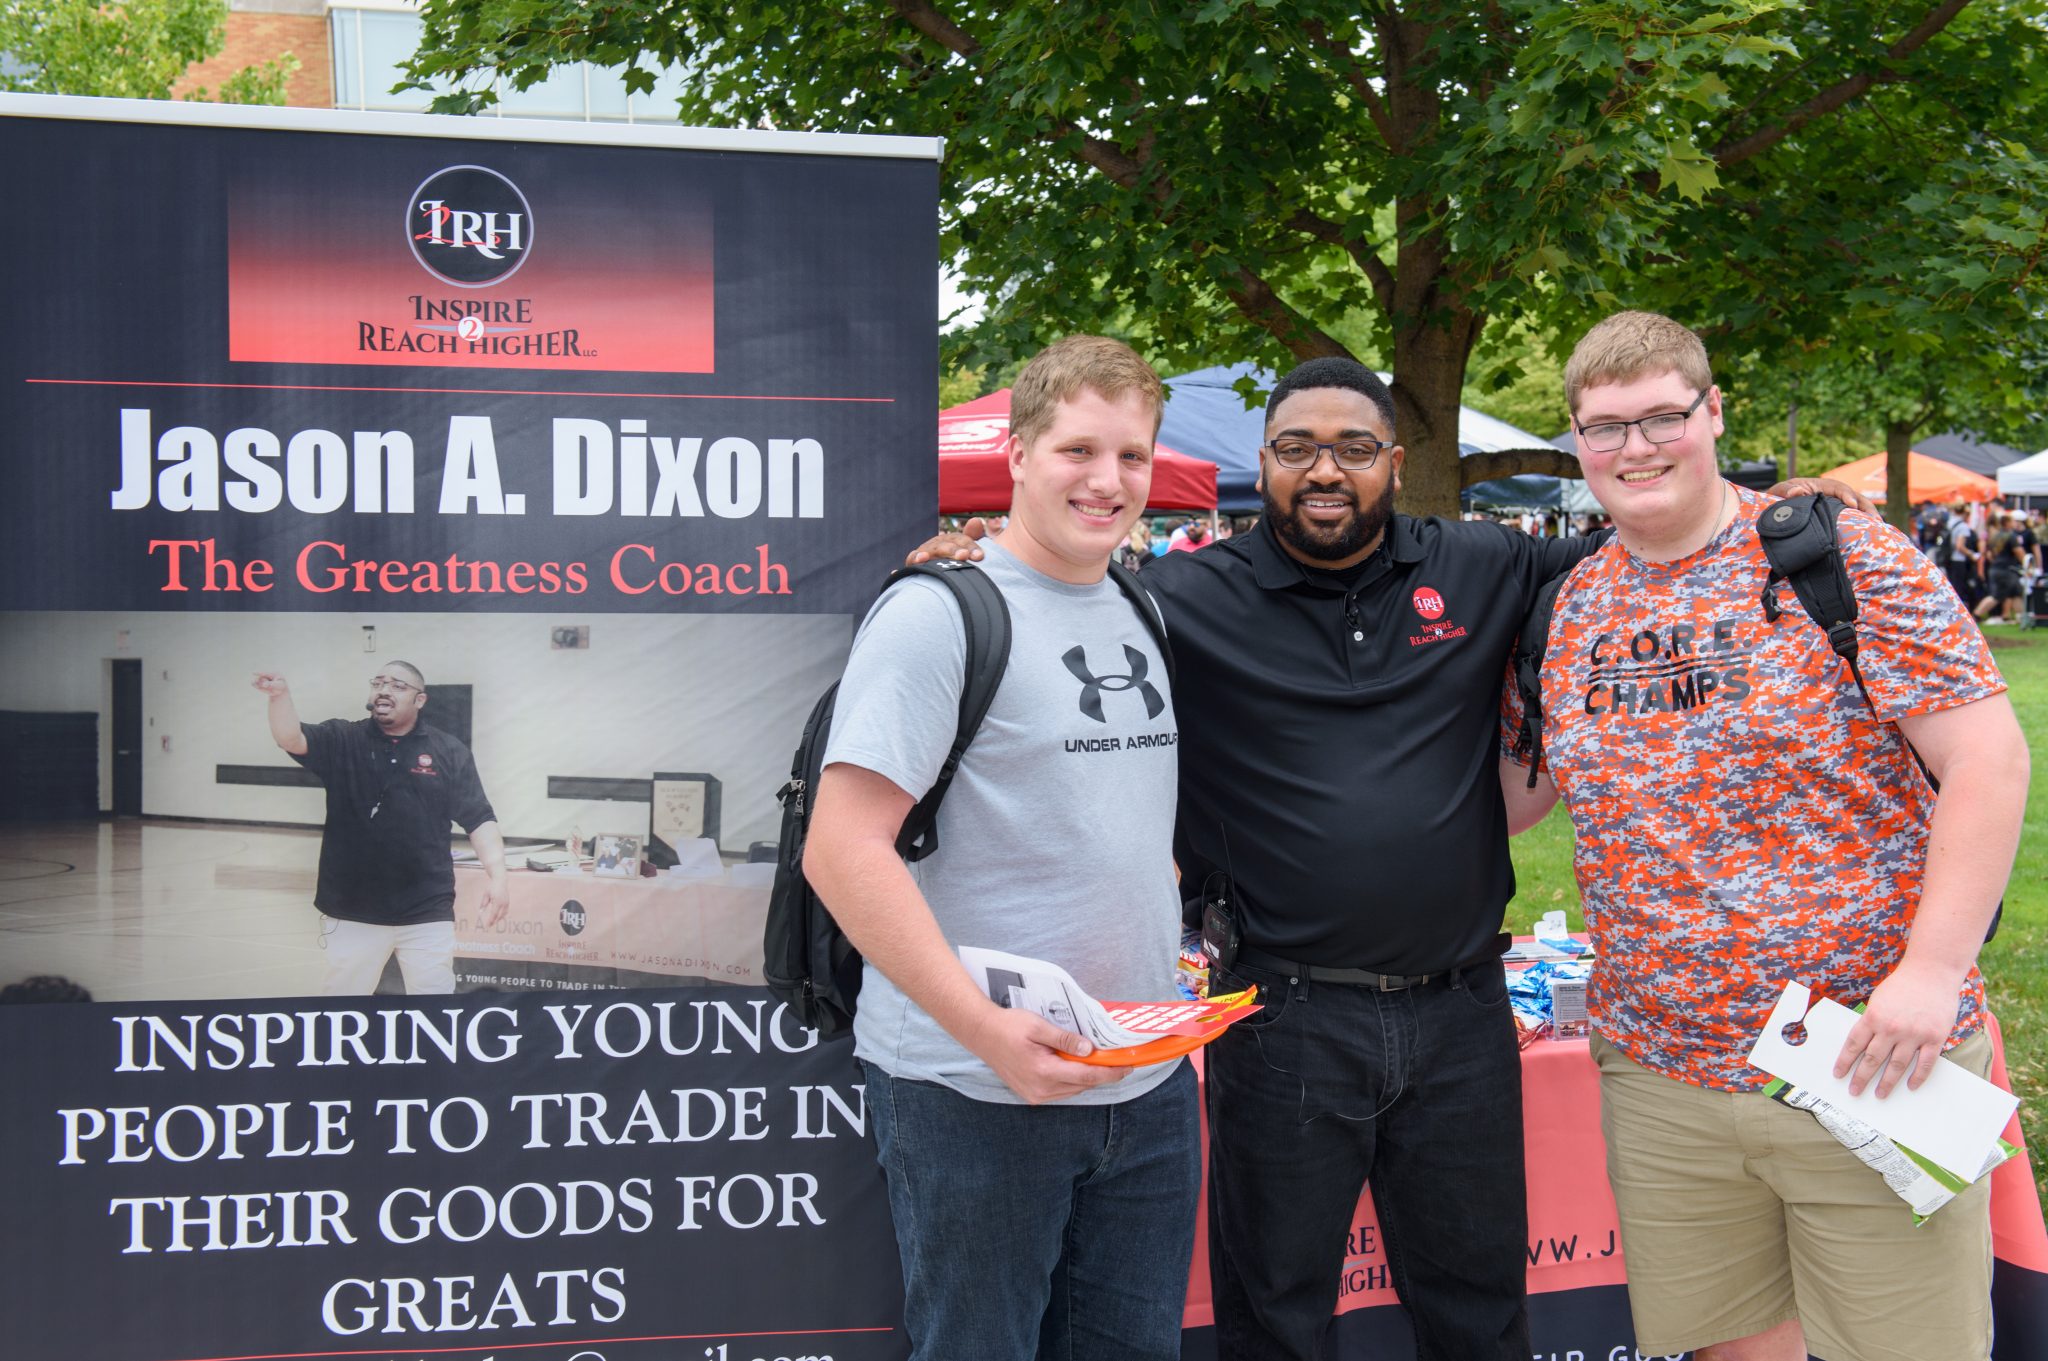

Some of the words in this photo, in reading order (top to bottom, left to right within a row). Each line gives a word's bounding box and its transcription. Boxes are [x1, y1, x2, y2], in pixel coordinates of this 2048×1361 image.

[408, 295, 532, 323] INSPIRE
[357, 321, 457, 353] REACH
[468, 329, 581, 356] HIGHER
[463, 320, 479, 339] 2
[111, 408, 414, 513] Jason
[439, 416, 525, 515] A.
[553, 418, 824, 518] Dixon
[149, 538, 273, 591] The
[296, 541, 588, 594] Greatness
[610, 544, 792, 595] Coach
[1409, 636, 1438, 646] REACH
[1440, 627, 1467, 639] HIGHER
[1421, 620, 1453, 632] INSPIRE
[1585, 667, 1751, 715] CHAMPS
[1065, 738, 1121, 752] UNDER
[496, 919, 543, 936] Dixon
[466, 975, 497, 984] YOUNG
[501, 976, 536, 988] PEOPLE
[540, 979, 553, 988] TO
[112, 1007, 523, 1072] INSPIRING
[542, 1000, 819, 1059] YOUNG
[57, 1103, 354, 1165] PEOPLE
[376, 1097, 489, 1153] TO
[510, 1086, 770, 1149] TRADE
[789, 1084, 867, 1139] IN
[109, 1190, 357, 1254] THEIR
[379, 1178, 653, 1244] GOODS
[675, 1172, 826, 1230] FOR
[321, 1267, 626, 1335] GREATS
